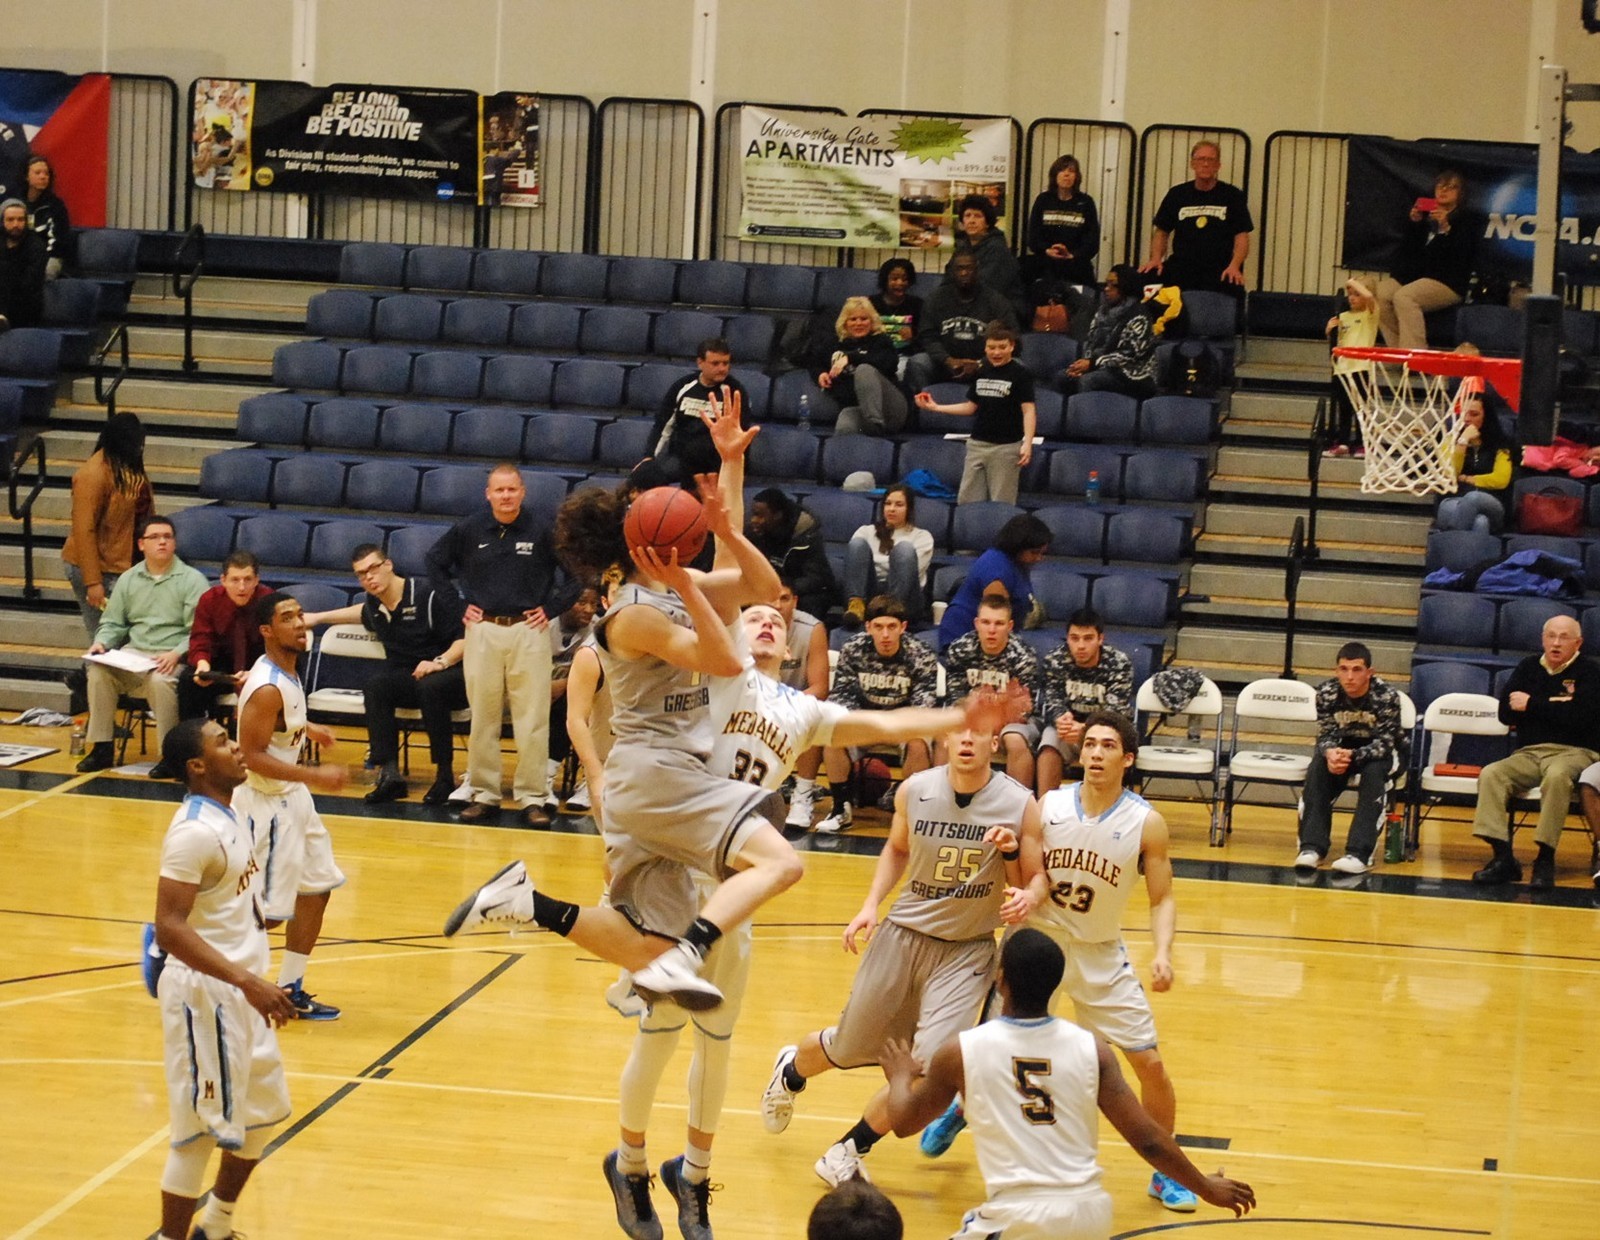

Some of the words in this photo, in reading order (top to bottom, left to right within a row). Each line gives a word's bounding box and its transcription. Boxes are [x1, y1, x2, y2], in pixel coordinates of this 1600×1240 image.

[332, 91, 355, 105] BE
[321, 103, 348, 118] BE
[349, 103, 410, 121] PROUD
[305, 116, 333, 135] BE
[335, 117, 423, 141] POSITIVE
[760, 117, 839, 148] University
[845, 126, 880, 147] Gate
[746, 139, 895, 167] APARTMENTS
[385, 167, 403, 176] and
[1483, 212, 1600, 246] NCA.
[914, 819, 991, 842] PITTSBUR
[933, 845, 984, 884] 25
[1050, 880, 1096, 915] 23
[204, 1079, 215, 1100] M
[1011, 1055, 1057, 1126] 5
